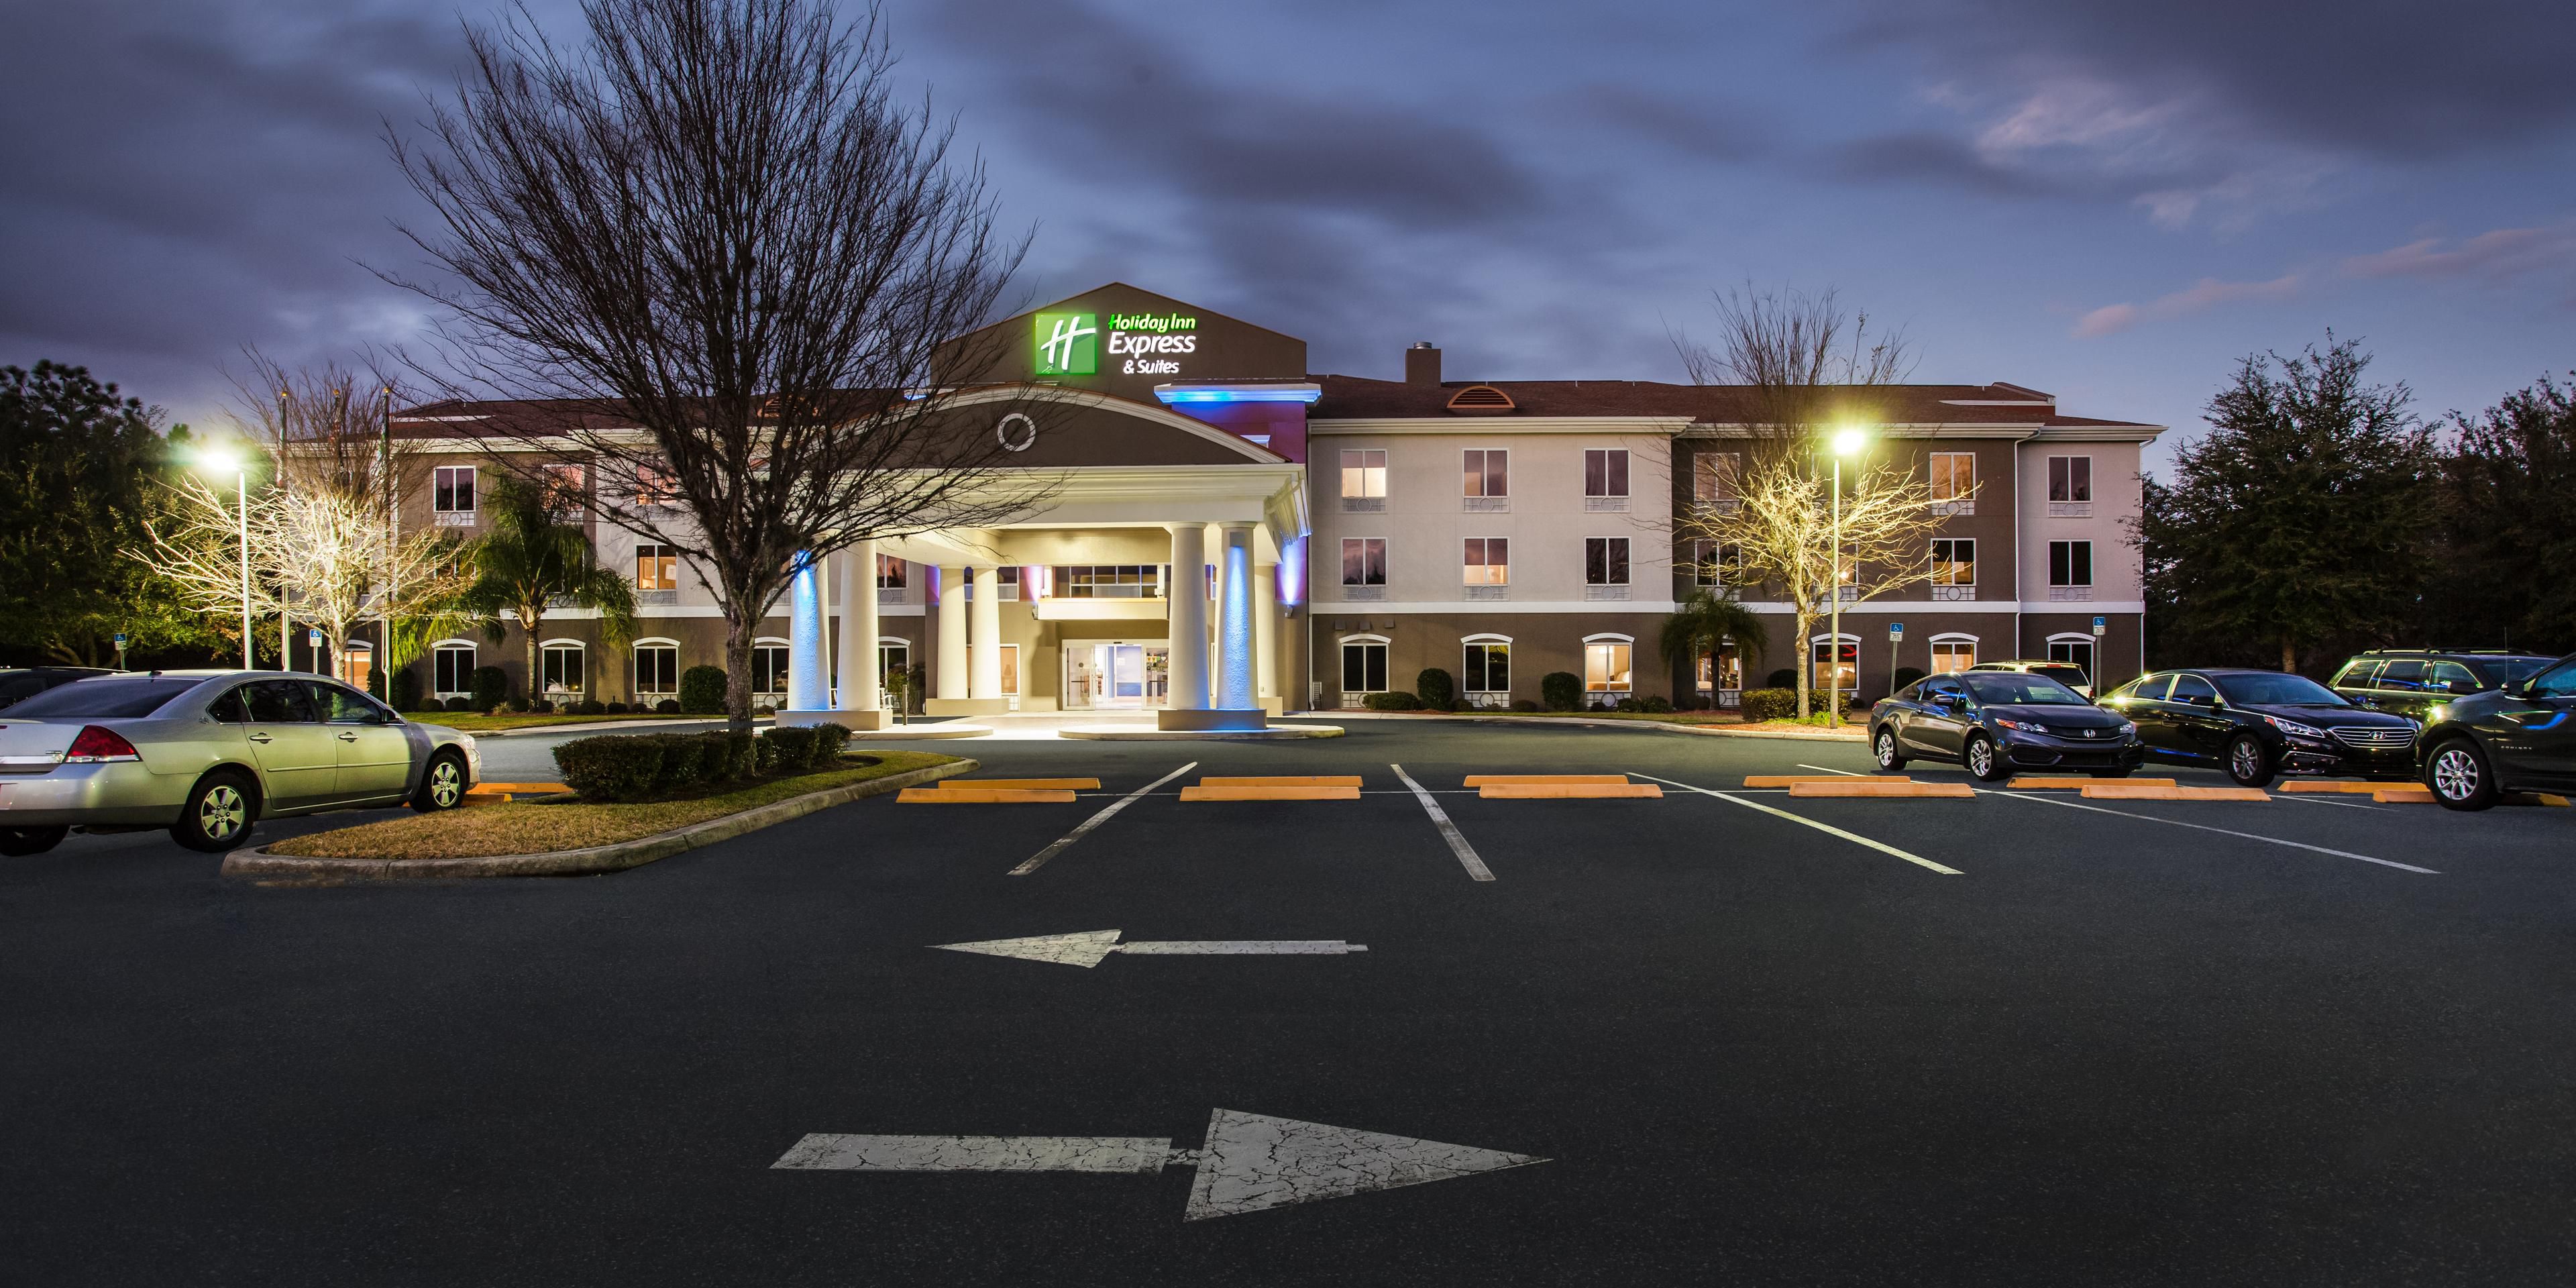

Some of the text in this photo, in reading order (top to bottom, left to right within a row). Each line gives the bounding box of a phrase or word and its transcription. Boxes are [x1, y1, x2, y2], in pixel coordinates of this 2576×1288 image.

[1108, 313, 1195, 333] Holiday Inn
[1108, 331, 1196, 358] Express
[1123, 360, 1179, 374] & Suites
